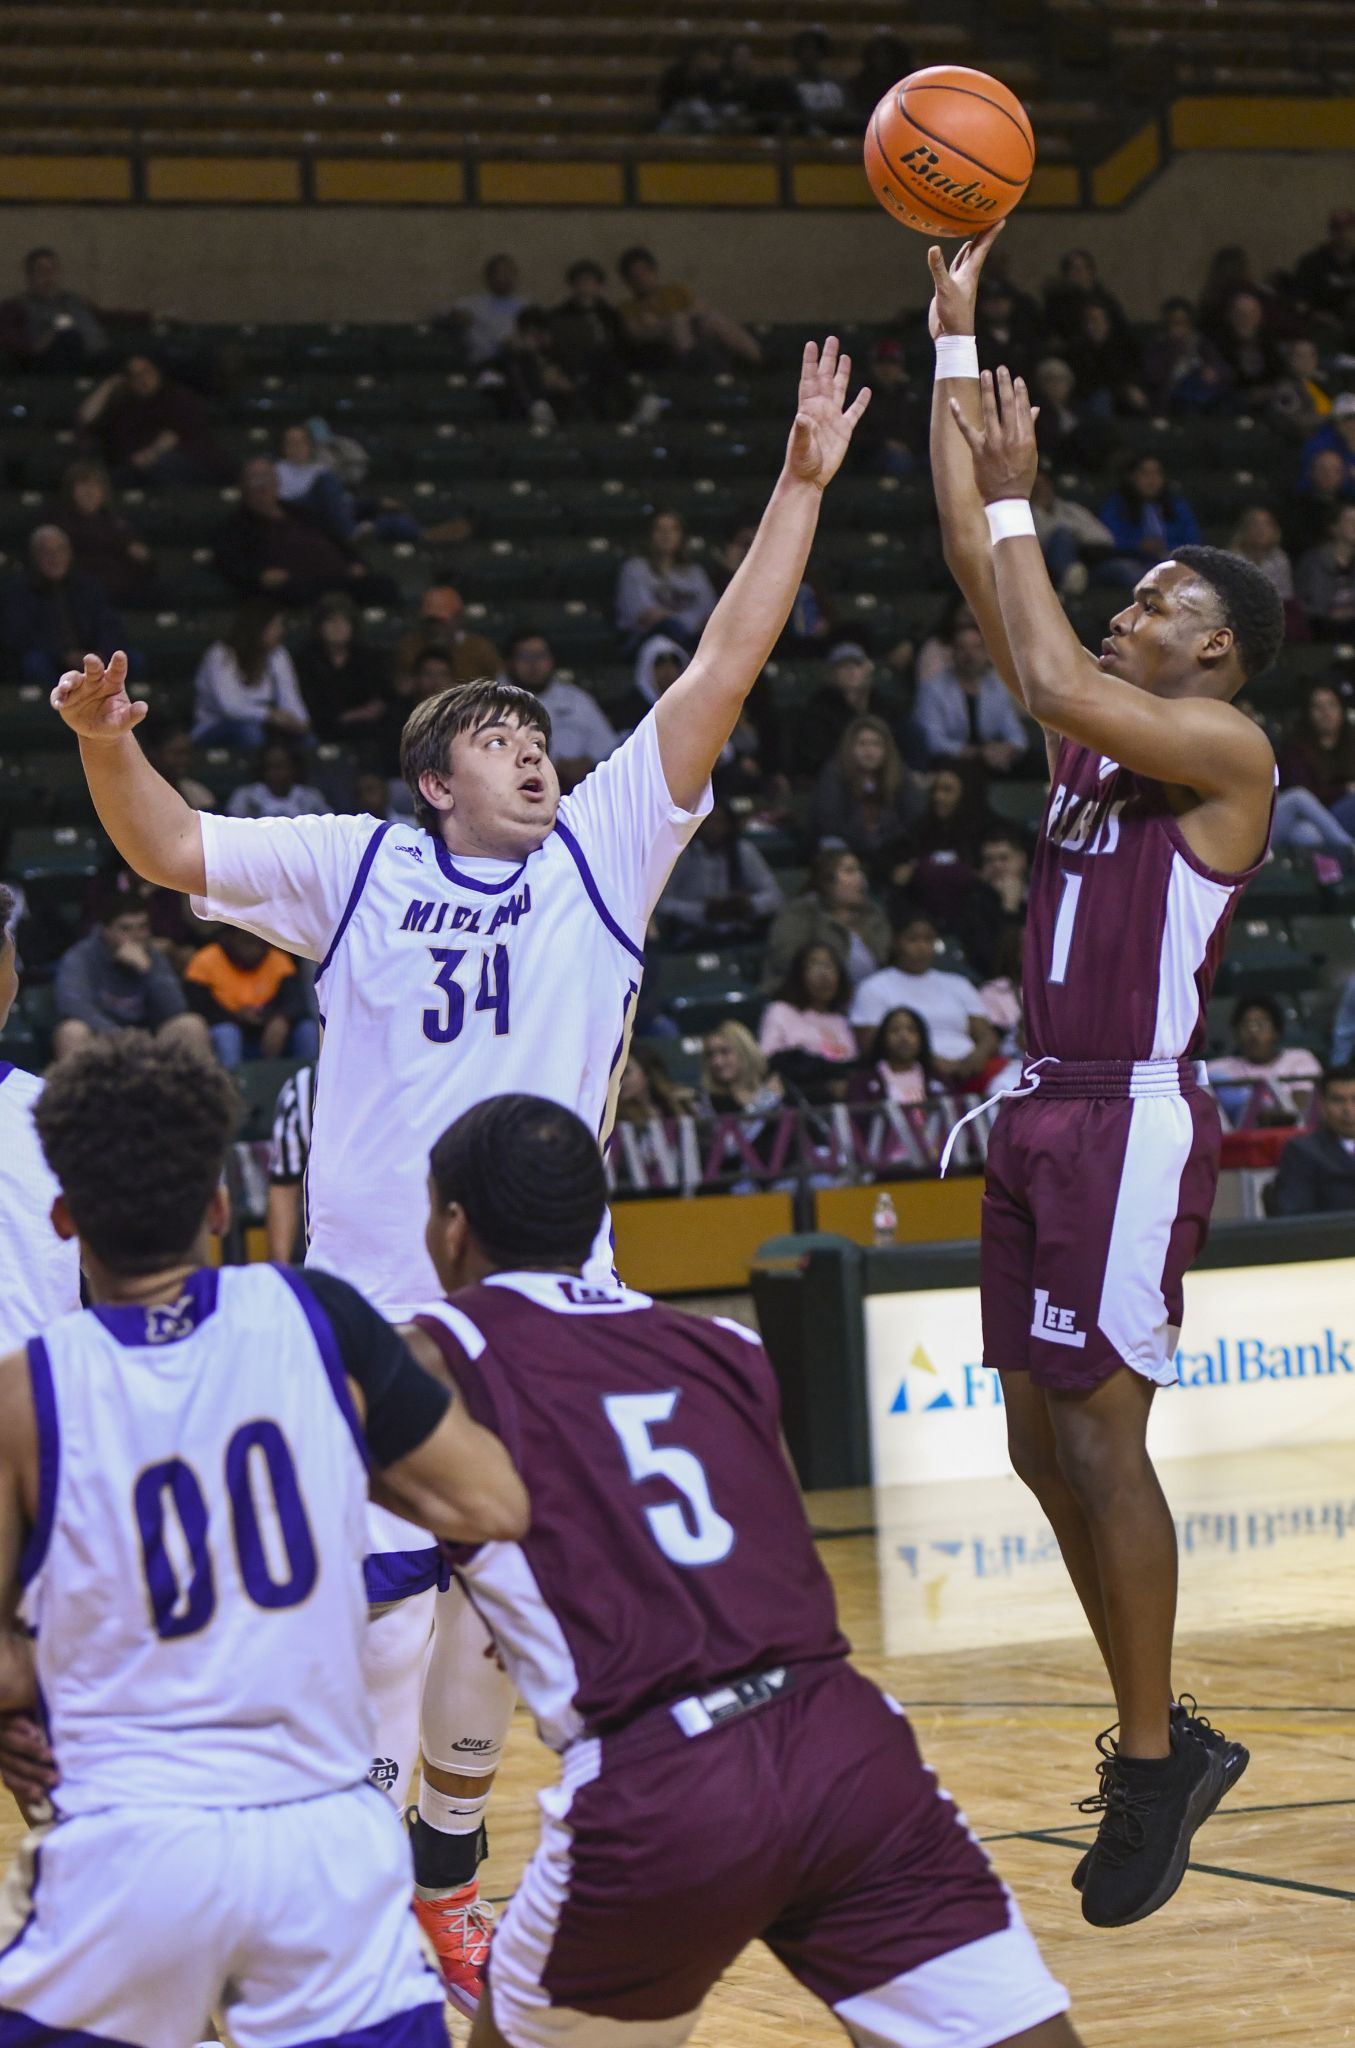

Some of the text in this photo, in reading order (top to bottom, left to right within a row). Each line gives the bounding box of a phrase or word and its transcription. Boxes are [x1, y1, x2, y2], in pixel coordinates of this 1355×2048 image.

[899, 144, 998, 213] Baden
[1049, 869, 1083, 985] 1
[421, 942, 513, 1044] 34
[1236, 1328, 1354, 1384] Bank
[600, 1387, 736, 1569] 5
[132, 1414, 320, 1643] 00
[367, 1766, 396, 1779] YBL
[459, 1737, 493, 1749] NIKE
